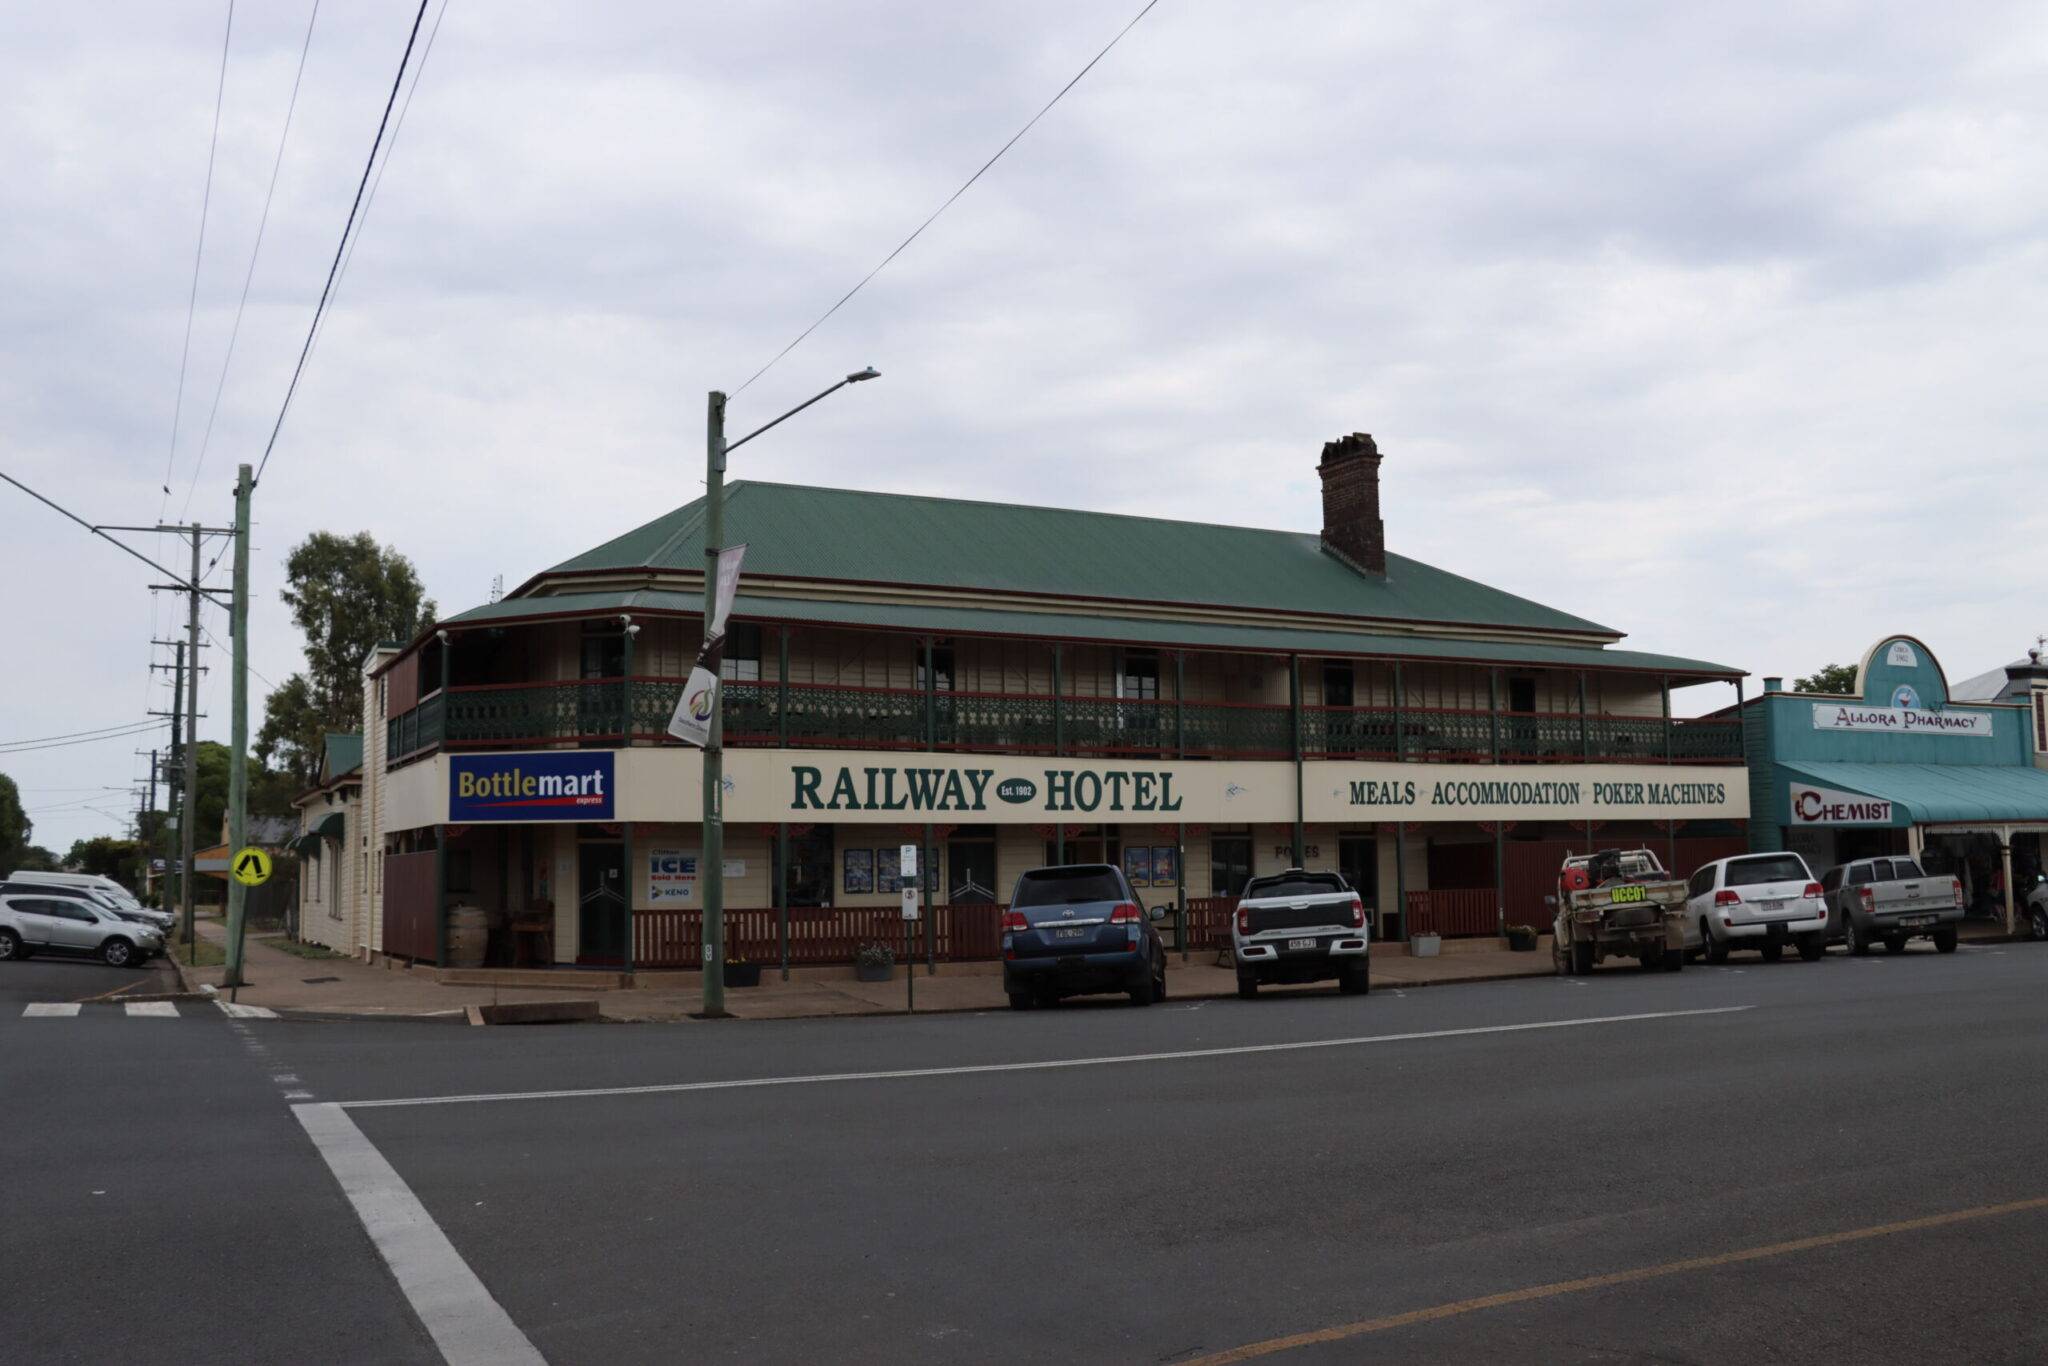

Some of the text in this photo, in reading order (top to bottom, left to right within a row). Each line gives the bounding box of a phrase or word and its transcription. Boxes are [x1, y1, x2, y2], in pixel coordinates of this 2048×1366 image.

[459, 768, 604, 797] Bottlemart
[791, 766, 1183, 812] RAILWAY HOTEL
[1001, 785, 1032, 796] Est. 1902
[1350, 781, 1726, 805] MEALS ACCOMMODATION POKER MACHINES
[576, 797, 603, 806] express
[1795, 791, 1891, 821] CHEMIST
[1275, 846, 1319, 859] POES
[651, 857, 696, 873] ICE
[665, 887, 690, 896] KENO
